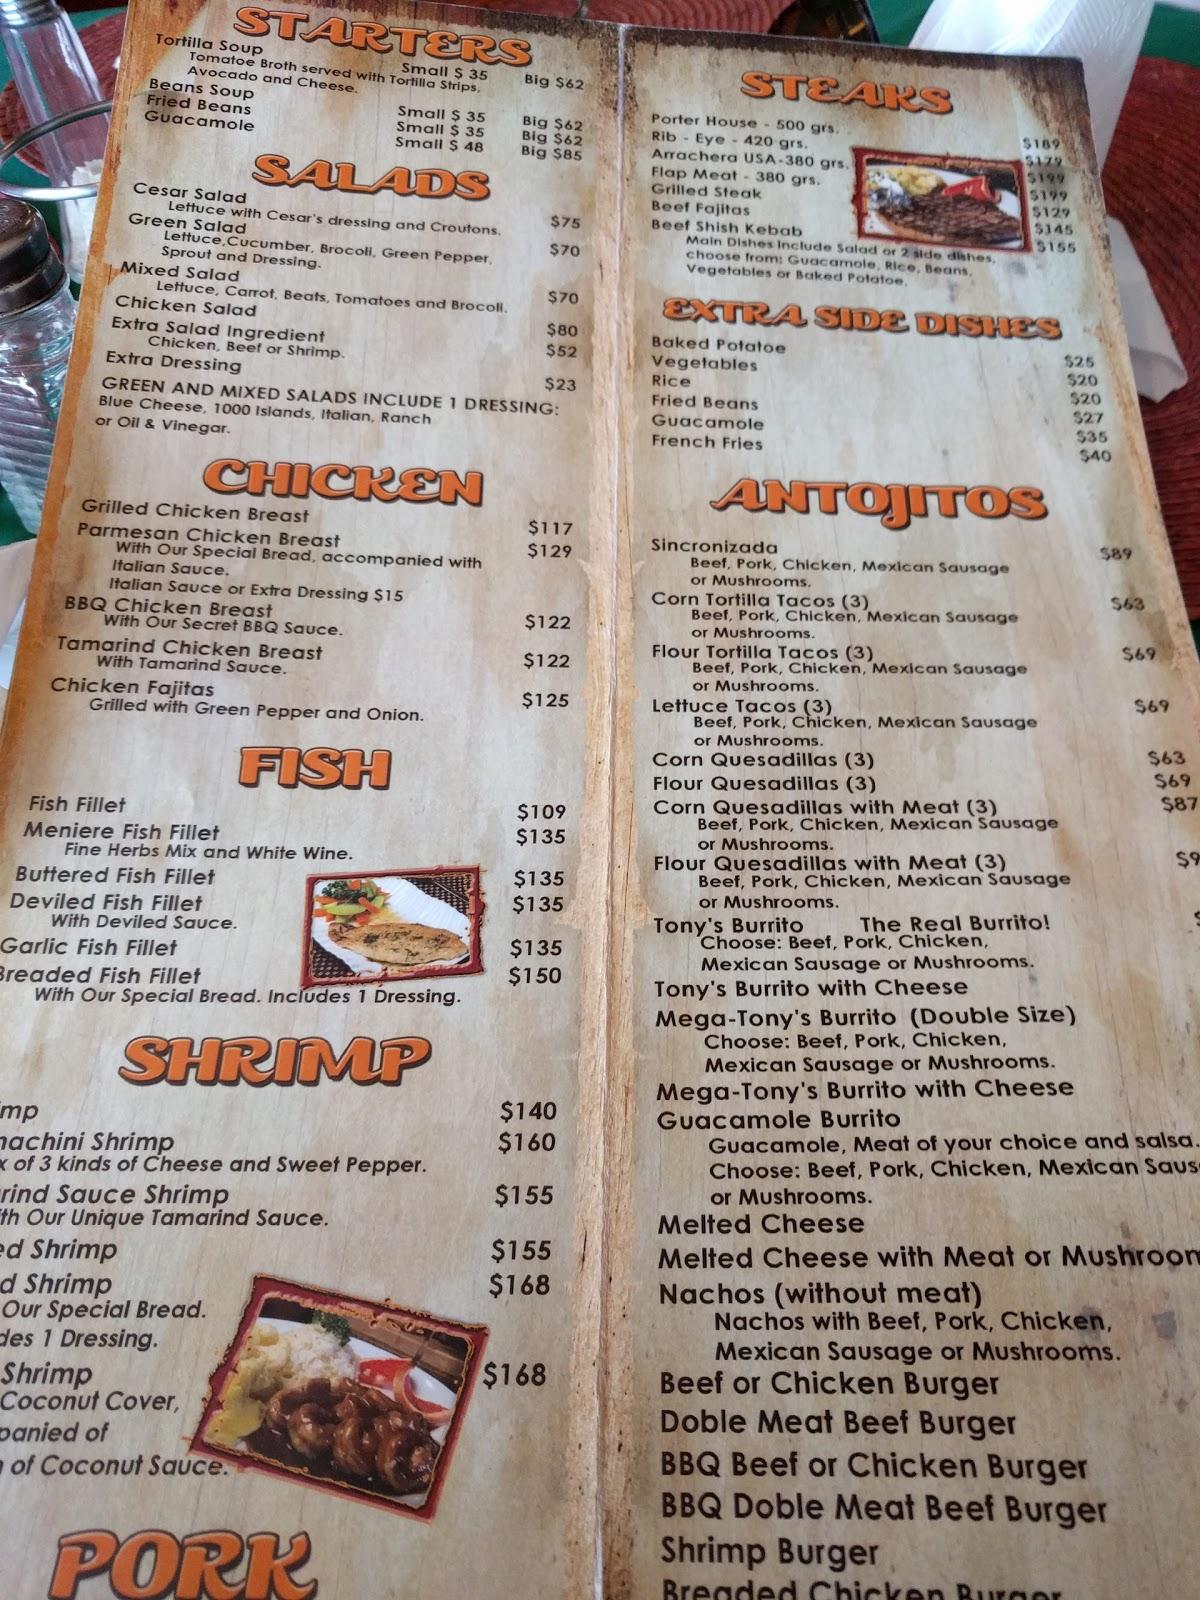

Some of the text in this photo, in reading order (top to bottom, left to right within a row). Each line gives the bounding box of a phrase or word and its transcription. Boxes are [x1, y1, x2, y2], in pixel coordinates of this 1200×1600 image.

[156, 33, 263, 57] Tortilla Soup
[233, 6, 533, 67] STARTERS
[186, 65, 357, 93] Avocado and Cheese.
[189, 51, 255, 67] Tomatoe
[260, 58, 297, 72] Broth
[301, 65, 352, 78] served
[356, 71, 385, 83] with
[389, 74, 435, 88] Tortilla
[401, 62, 448, 77] Small
[468, 68, 488, 81] 35
[149, 77, 254, 101] Beans Soup
[524, 73, 584, 90] Big $62
[740, 70, 954, 115] STEAKS
[146, 94, 251, 115] Fried Beans
[144, 110, 255, 132] Guacamole
[651, 112, 700, 125] Porter
[706, 115, 757, 128] House
[776, 119, 805, 131] 500
[810, 123, 839, 135] grs.
[651, 148, 738, 163] Arrachera
[820, 157, 849, 171] grs.
[252, 154, 491, 201] SALADS
[133, 182, 247, 204] Cesar Salad
[651, 183, 761, 199] Grilled Steak
[168, 200, 226, 216] Lettuce
[230, 207, 262, 219] with
[266, 209, 323, 224] Cesar's
[328, 215, 391, 231] dressing
[395, 221, 425, 231] and
[651, 199, 750, 217] Beef Fajitas
[550, 214, 581, 229] $75
[381, 247, 429, 260] Green
[685, 235, 722, 246] Main
[836, 242, 877, 255] Salad
[882, 248, 896, 256] or
[160, 245, 321, 270] Sprout and Dressing.
[119, 261, 240, 282] Mixed Salad
[115, 294, 257, 317] Chicken Salad
[111, 315, 325, 343] Extra Salad Ingredient
[546, 322, 578, 337] $80
[662, 298, 1063, 340] EXTRA SIDE DISHES
[651, 335, 786, 354] Baked Potatoe
[1063, 353, 1095, 369] $25
[652, 374, 691, 387] Rice
[101, 376, 558, 416] GREEN AND MIXED SALADS INCLUDE 1 DRESSING:
[95, 416, 230, 436] or Oil & Vinegar.
[652, 433, 763, 451] French Fries
[1079, 448, 1112, 464] $40
[203, 458, 483, 506] CHICKEN
[81, 498, 309, 523] Grilled Chicken Breast
[710, 478, 1049, 530] ANTOJITOS
[528, 519, 573, 536] $117
[116, 540, 151, 554] With
[156, 542, 188, 556] Our
[192, 544, 257, 559] Special
[321, 553, 443, 567] accompanied
[447, 556, 482, 569] with
[651, 537, 778, 554] Sincronizada
[1099, 546, 1132, 561] $89
[690, 556, 1010, 576] Beef, Pork, Chicken, Mexican Sausage
[690, 574, 811, 588] or Mushrooms.
[651, 591, 869, 611] Corn Tortilla Tacos (3)
[1110, 596, 1145, 612] $63
[239, 746, 391, 790] FISH
[28, 795, 126, 813] Fish Fillet
[517, 803, 566, 822] $109
[64, 841, 353, 860] Fine Herbs Mix and White Wine.
[653, 916, 804, 937] Tony's Burrito
[859, 914, 1050, 933] The Real Burrito!
[655, 1008, 896, 1031] Mega-Tony's Burrito
[910, 1005, 1076, 1029] (Double Size)
[119, 1035, 431, 1087] SHRIMP
[500, 1100, 557, 1123] $140
[656, 1108, 901, 1130] Guacamole Burrito
[657, 1213, 864, 1235] Melted Cheese
[482, 1362, 548, 1387] $168
[662, 1491, 1107, 1530] BBQ Doble Meat Beef Burger
[48, 1529, 319, 1600] PORK
[661, 1535, 879, 1573] Shrimp Burger
